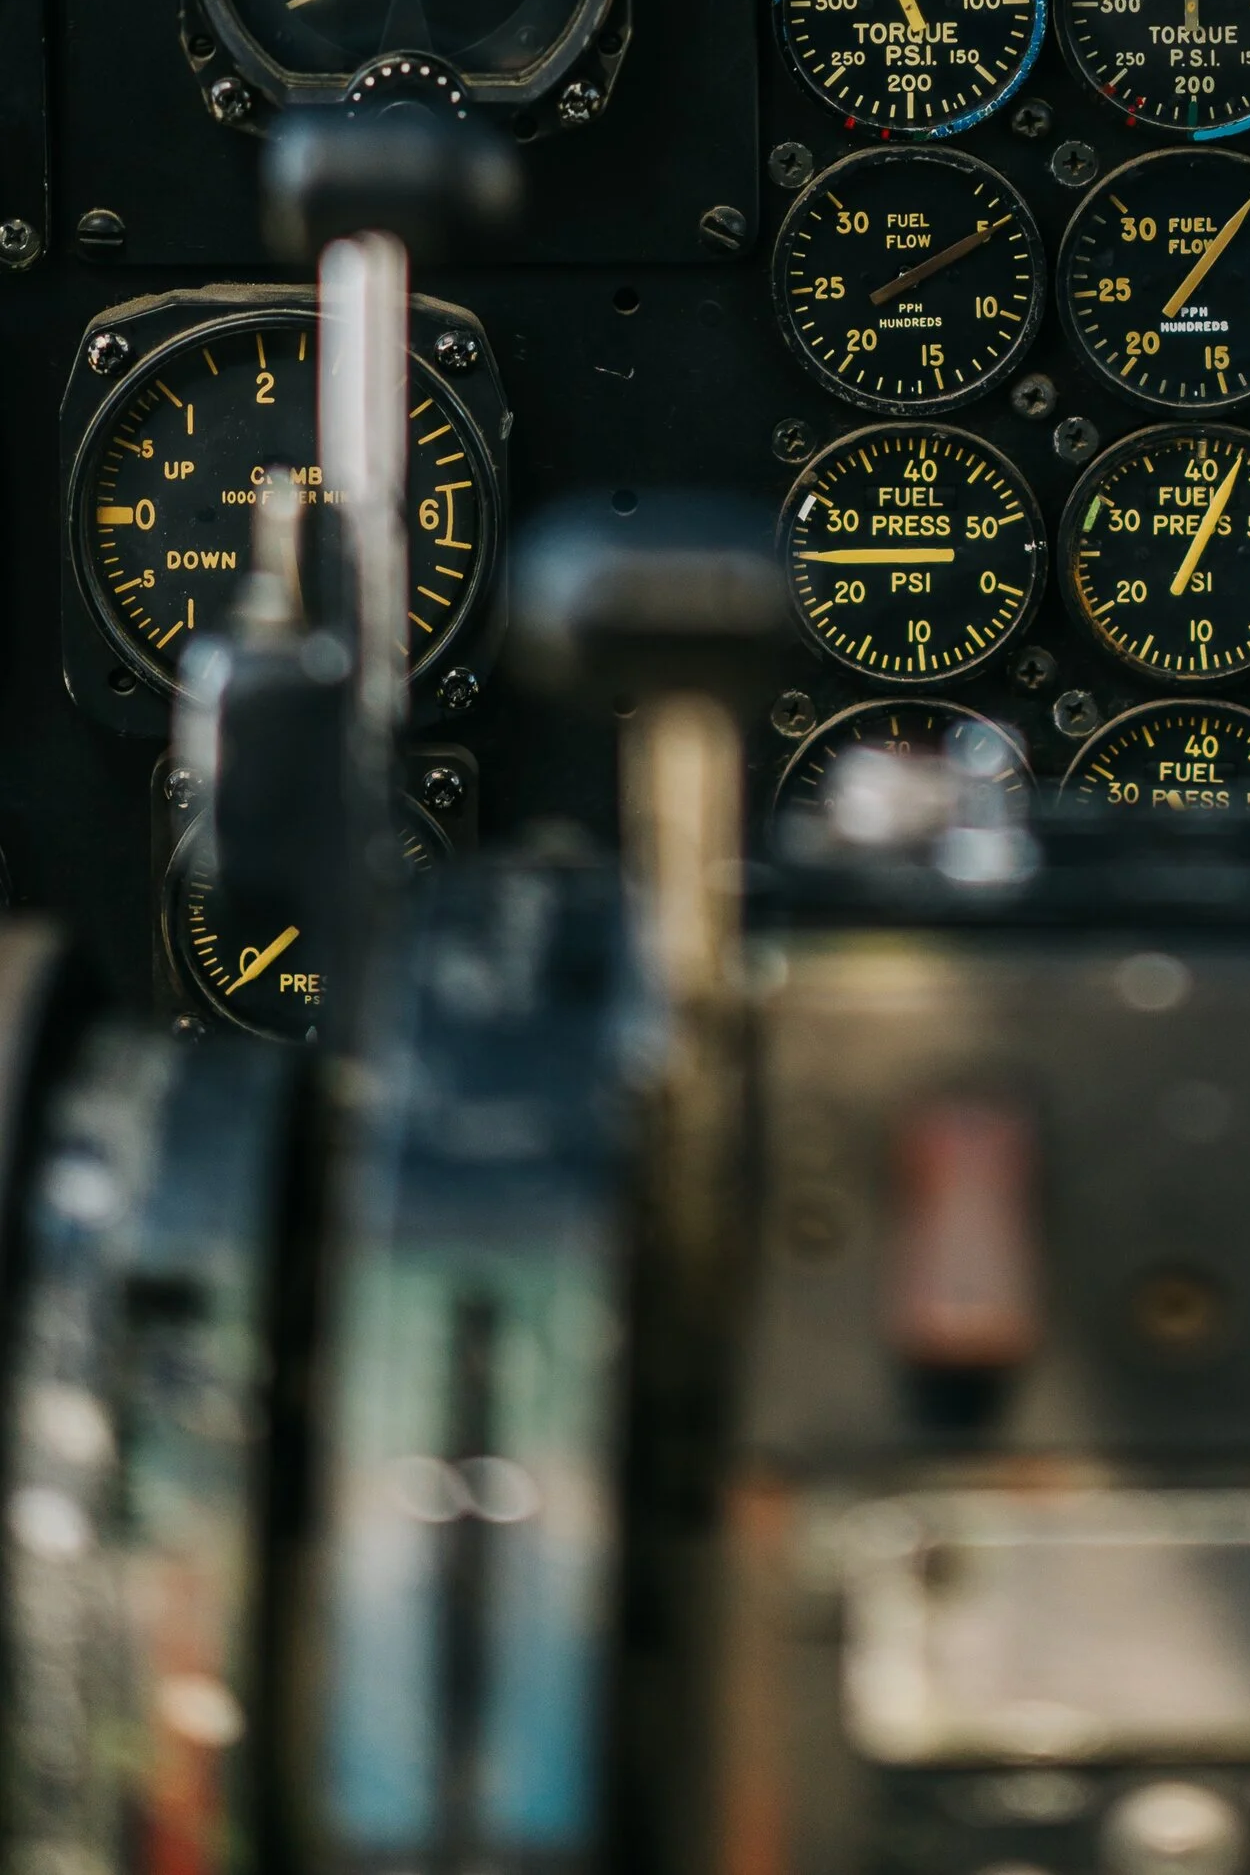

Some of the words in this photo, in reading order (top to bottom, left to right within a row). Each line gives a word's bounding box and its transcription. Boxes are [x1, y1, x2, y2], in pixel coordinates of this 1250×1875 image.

[853, 22, 958, 44] TORQUE
[1149, 26, 1238, 43] TORQUE
[831, 52, 865, 65] 250
[950, 50, 979, 64] 150
[888, 75, 932, 92] 200
[1175, 76, 1215, 94] 200
[836, 211, 869, 234] 30
[887, 214, 930, 228] FUEL
[1121, 217, 1157, 242] 30
[1168, 217, 1217, 233] FUEL
[886, 234, 932, 249] FLOW
[815, 276, 846, 300] 25
[899, 303, 922, 313] PPH
[1181, 307, 1207, 317] PPH
[880, 317, 942, 328] HUNDREDS
[1160, 321, 1229, 332] HUNDREDS
[847, 329, 877, 351] 20
[1125, 331, 1160, 355] 20
[922, 344, 944, 367] 15
[256, 373, 275, 404] 2
[164, 461, 195, 479] UP
[904, 459, 937, 482] 40
[1185, 458, 1219, 482] 40
[222, 490, 256, 504] 1000
[879, 487, 943, 507] FUEL
[419, 499, 439, 530] 6
[827, 510, 860, 532] 30
[872, 516, 950, 536] PRESS
[965, 516, 998, 539] 50
[166, 551, 236, 569] DOWN
[835, 581, 865, 604] 20
[891, 572, 931, 593] PSI
[1184, 735, 1219, 758] 40
[1159, 762, 1223, 784] FUEL
[1107, 783, 1140, 805] 30
